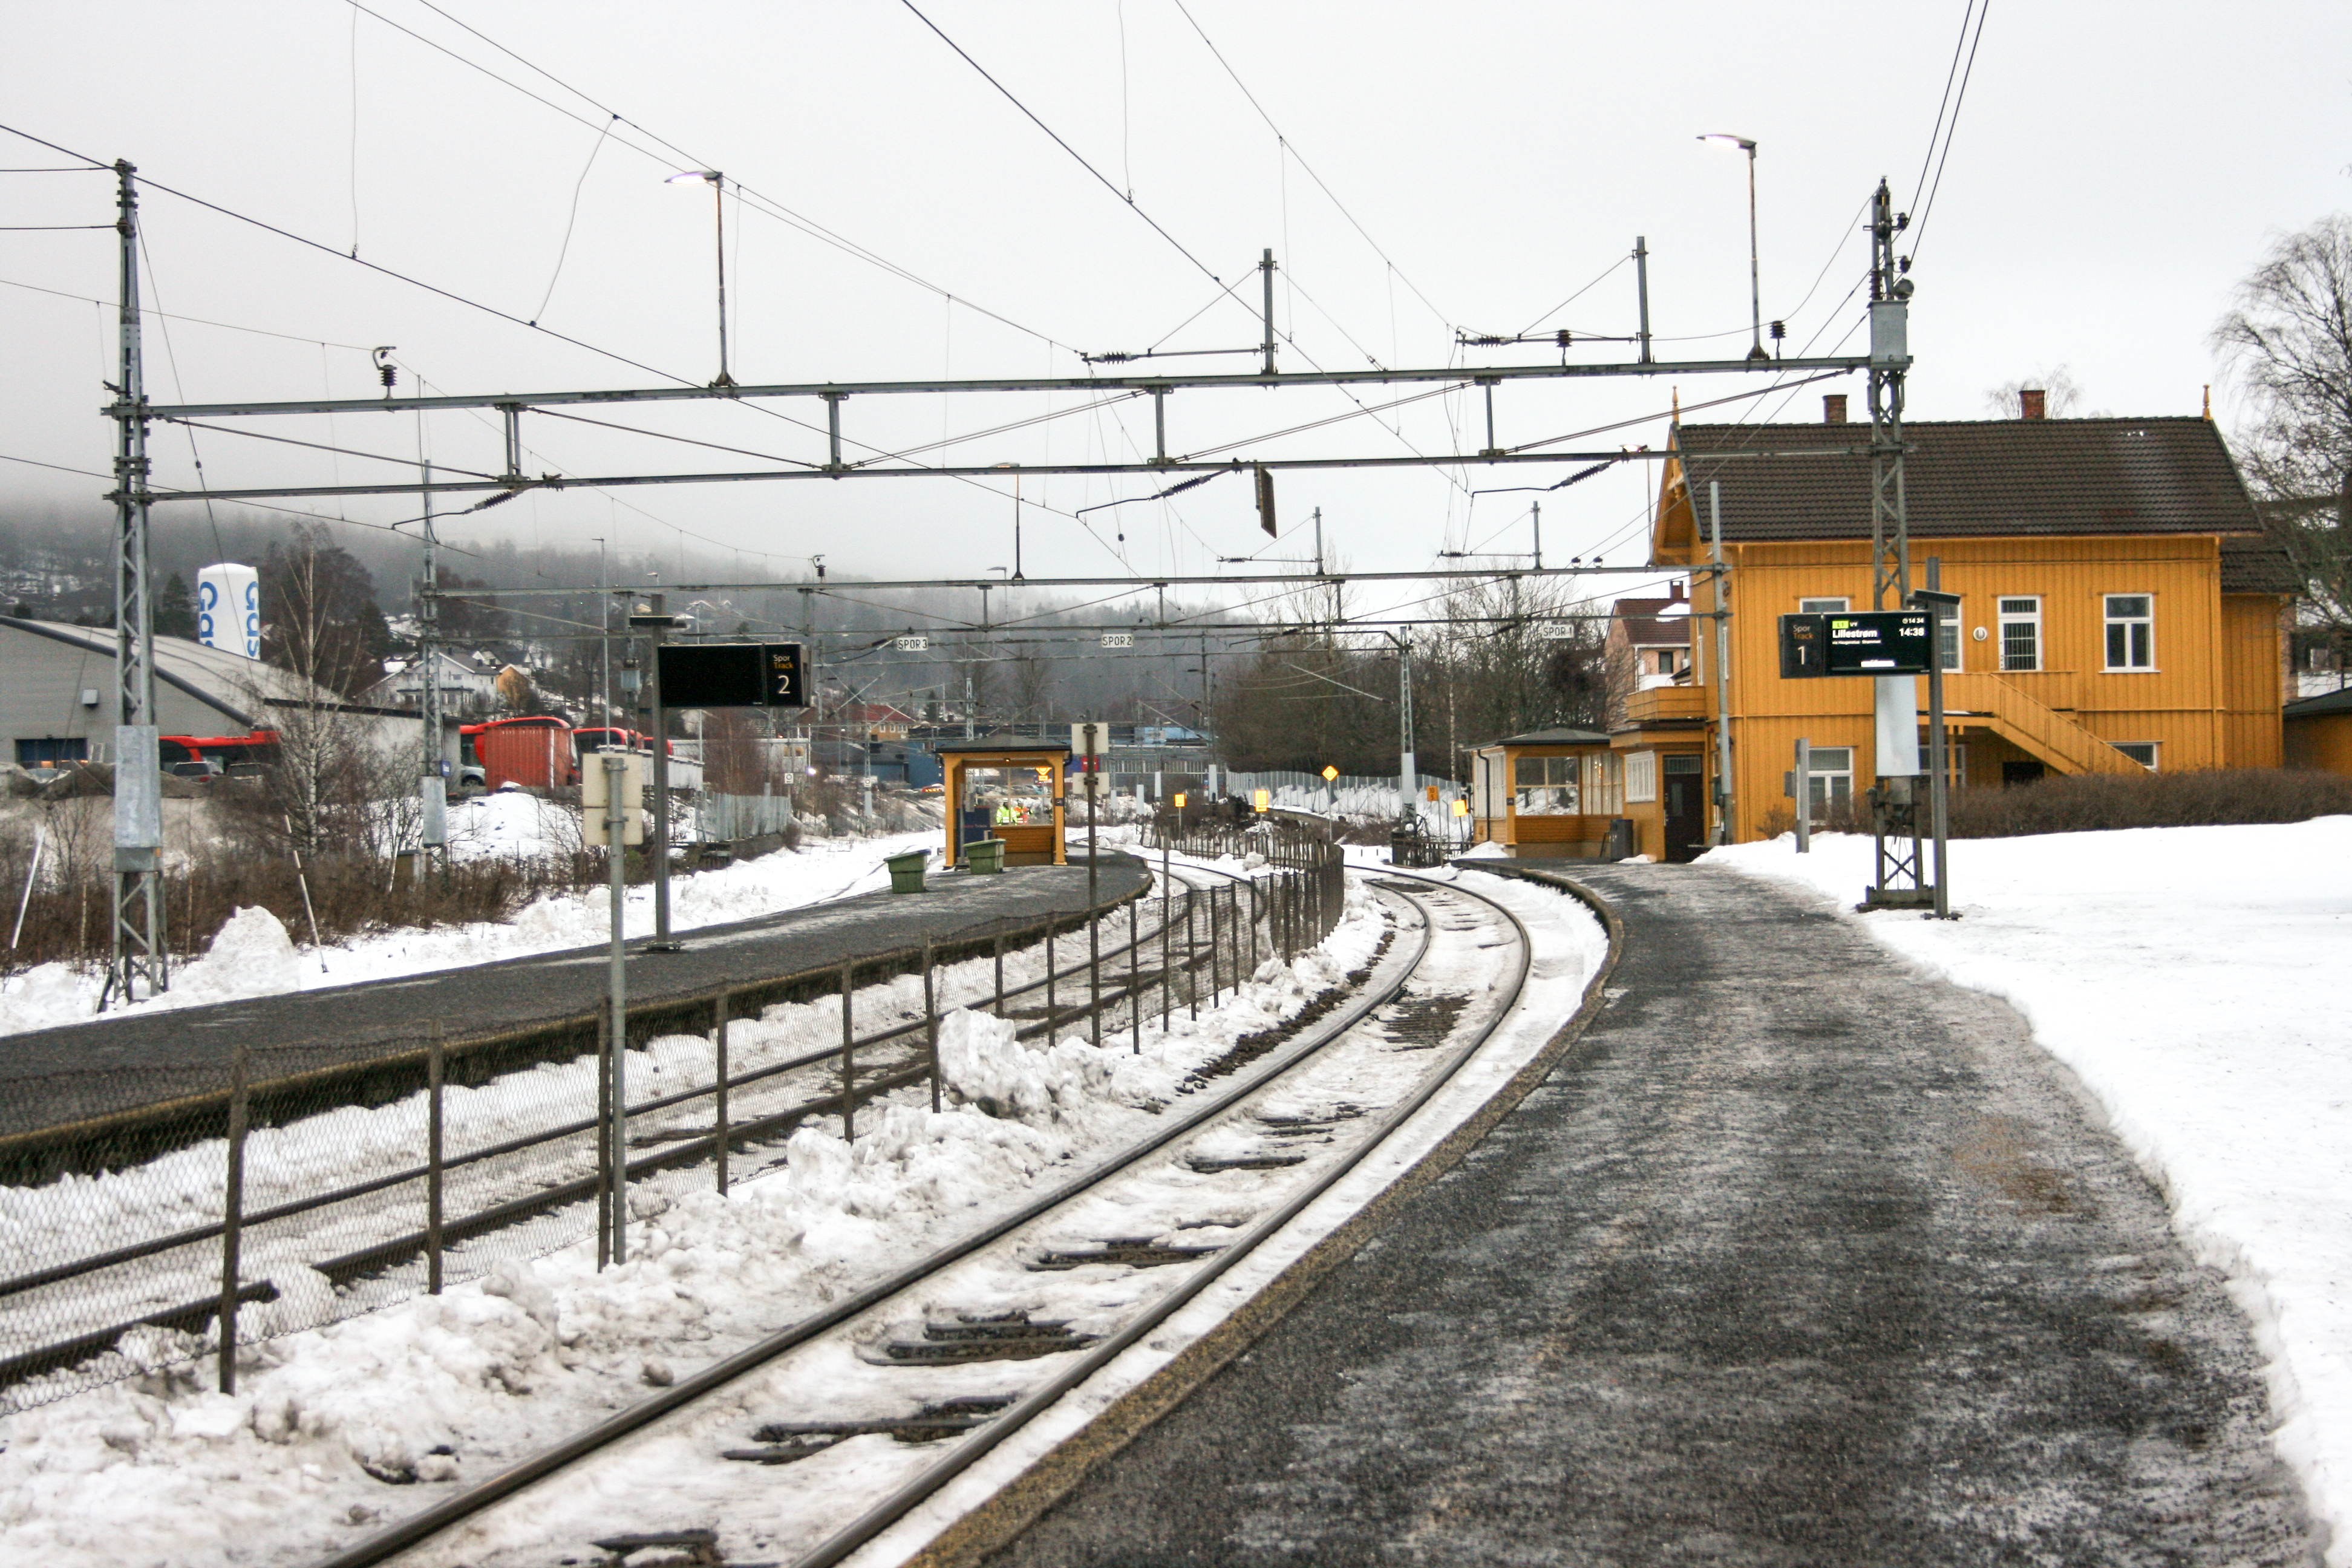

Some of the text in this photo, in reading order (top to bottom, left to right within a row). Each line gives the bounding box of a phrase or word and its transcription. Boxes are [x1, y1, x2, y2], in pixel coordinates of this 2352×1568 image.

[1543, 627, 1566, 636] SPOR
[1832, 630, 1878, 638] Lillestrøm
[1899, 627, 1924, 636] 14:38
[898, 639, 927, 649] SPOR 3
[1103, 636, 1132, 645] SPOR 2
[1797, 645, 1805, 665] 1
[779, 675, 790, 694] 2
